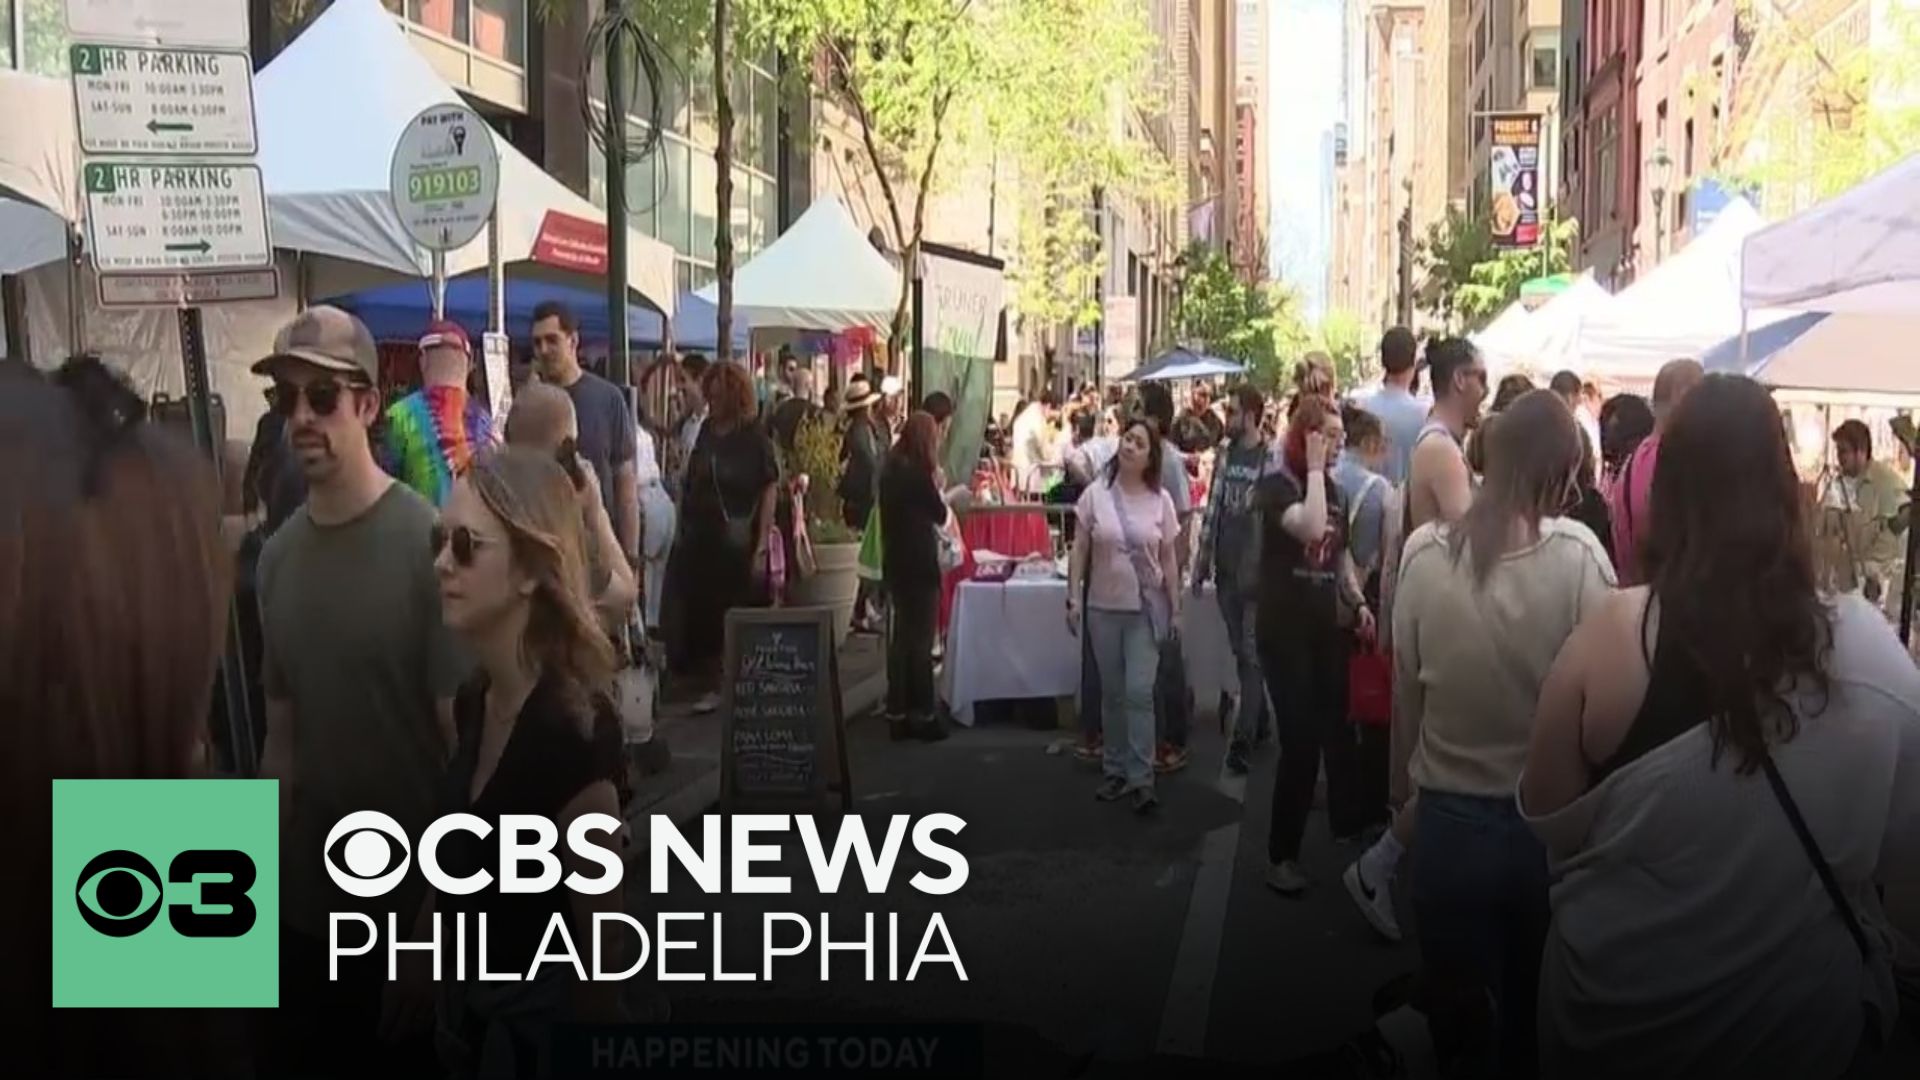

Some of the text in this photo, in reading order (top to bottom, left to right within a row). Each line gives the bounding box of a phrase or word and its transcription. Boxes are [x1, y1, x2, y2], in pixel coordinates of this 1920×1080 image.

[79, 49, 220, 75] 2 HR PARKING
[93, 168, 233, 189] 2 HR PARKING
[410, 168, 480, 200] 919103
